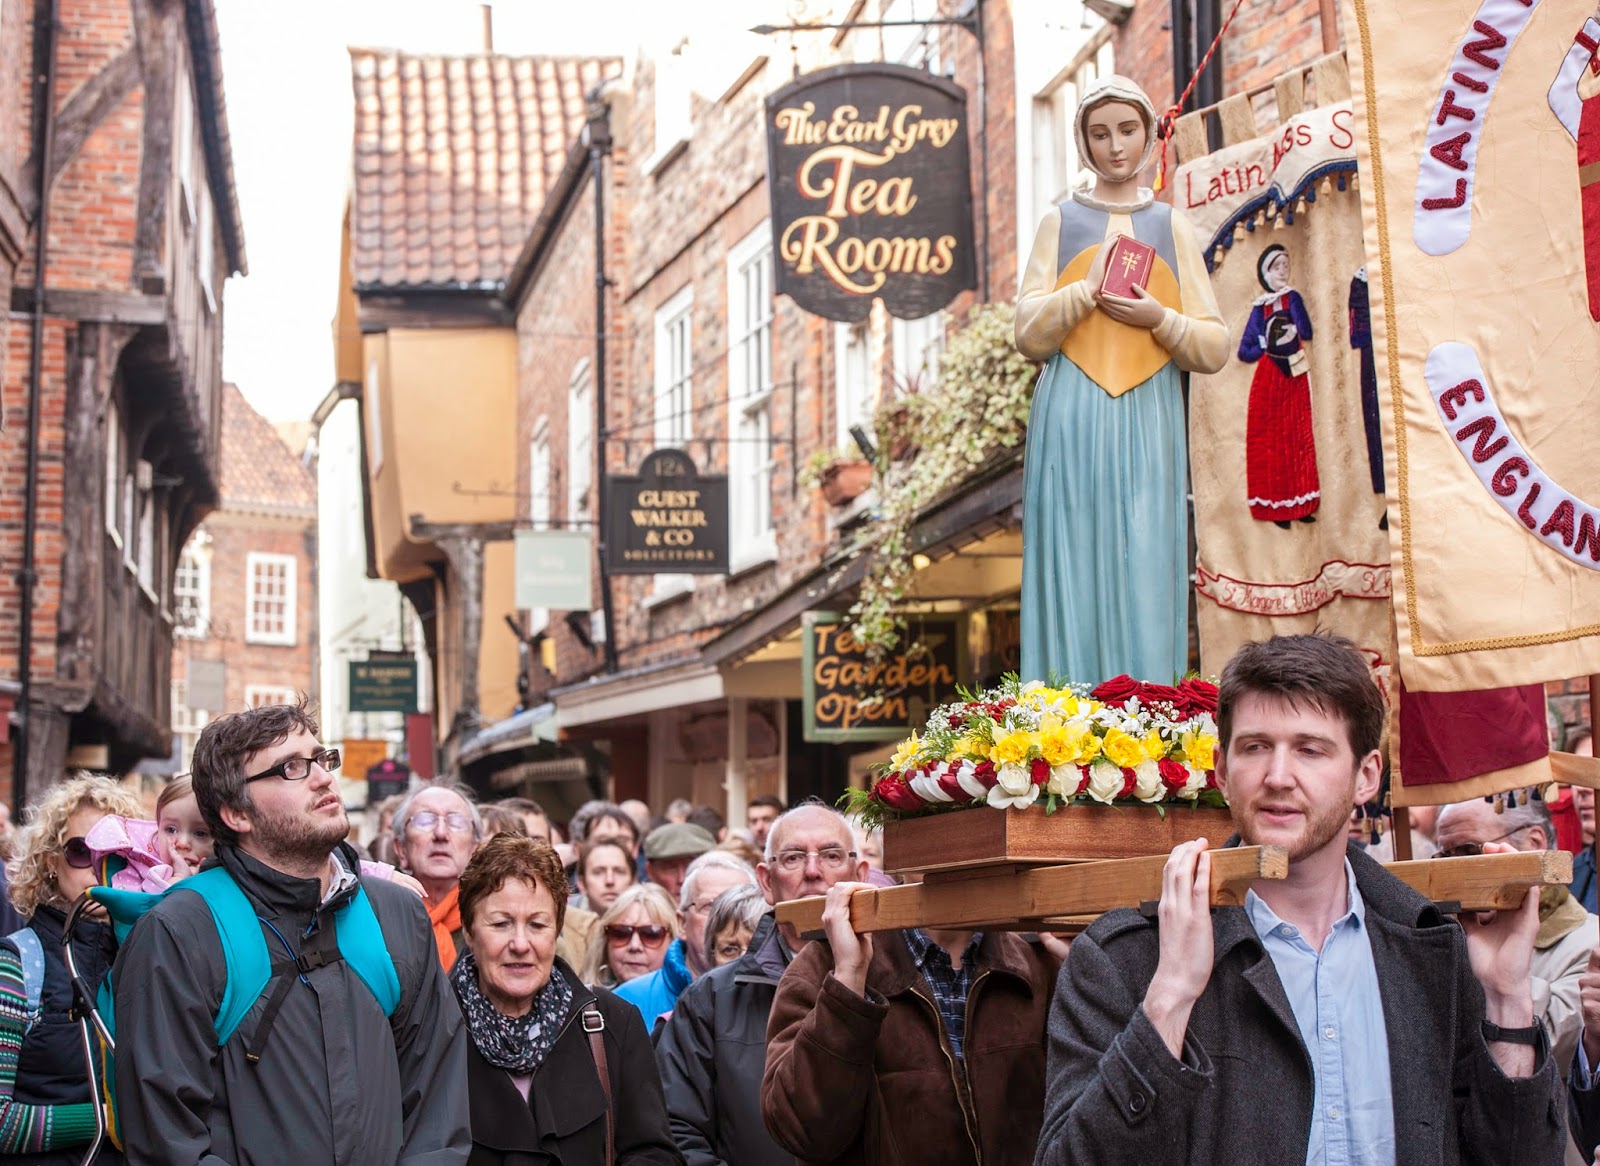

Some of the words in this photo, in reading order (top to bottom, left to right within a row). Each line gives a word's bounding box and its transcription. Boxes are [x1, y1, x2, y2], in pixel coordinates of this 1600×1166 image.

[775, 101, 826, 145] The
[827, 105, 890, 144] Earl
[889, 105, 958, 153] Grey
[1421, 20, 1507, 210] LATIN
[797, 145, 918, 218] Tea
[1186, 161, 1265, 209] Latin
[1270, 124, 1312, 176] Mss
[780, 215, 957, 295] Rooms
[1439, 378, 1600, 562] ENGLAN
[630, 509, 708, 527] WALKER
[638, 489, 701, 508] GUEST
[645, 530, 661, 546] &
[663, 528, 695, 546] CO
[814, 625, 867, 655] Te
[814, 654, 954, 690] Garden
[814, 692, 909, 729] Open
